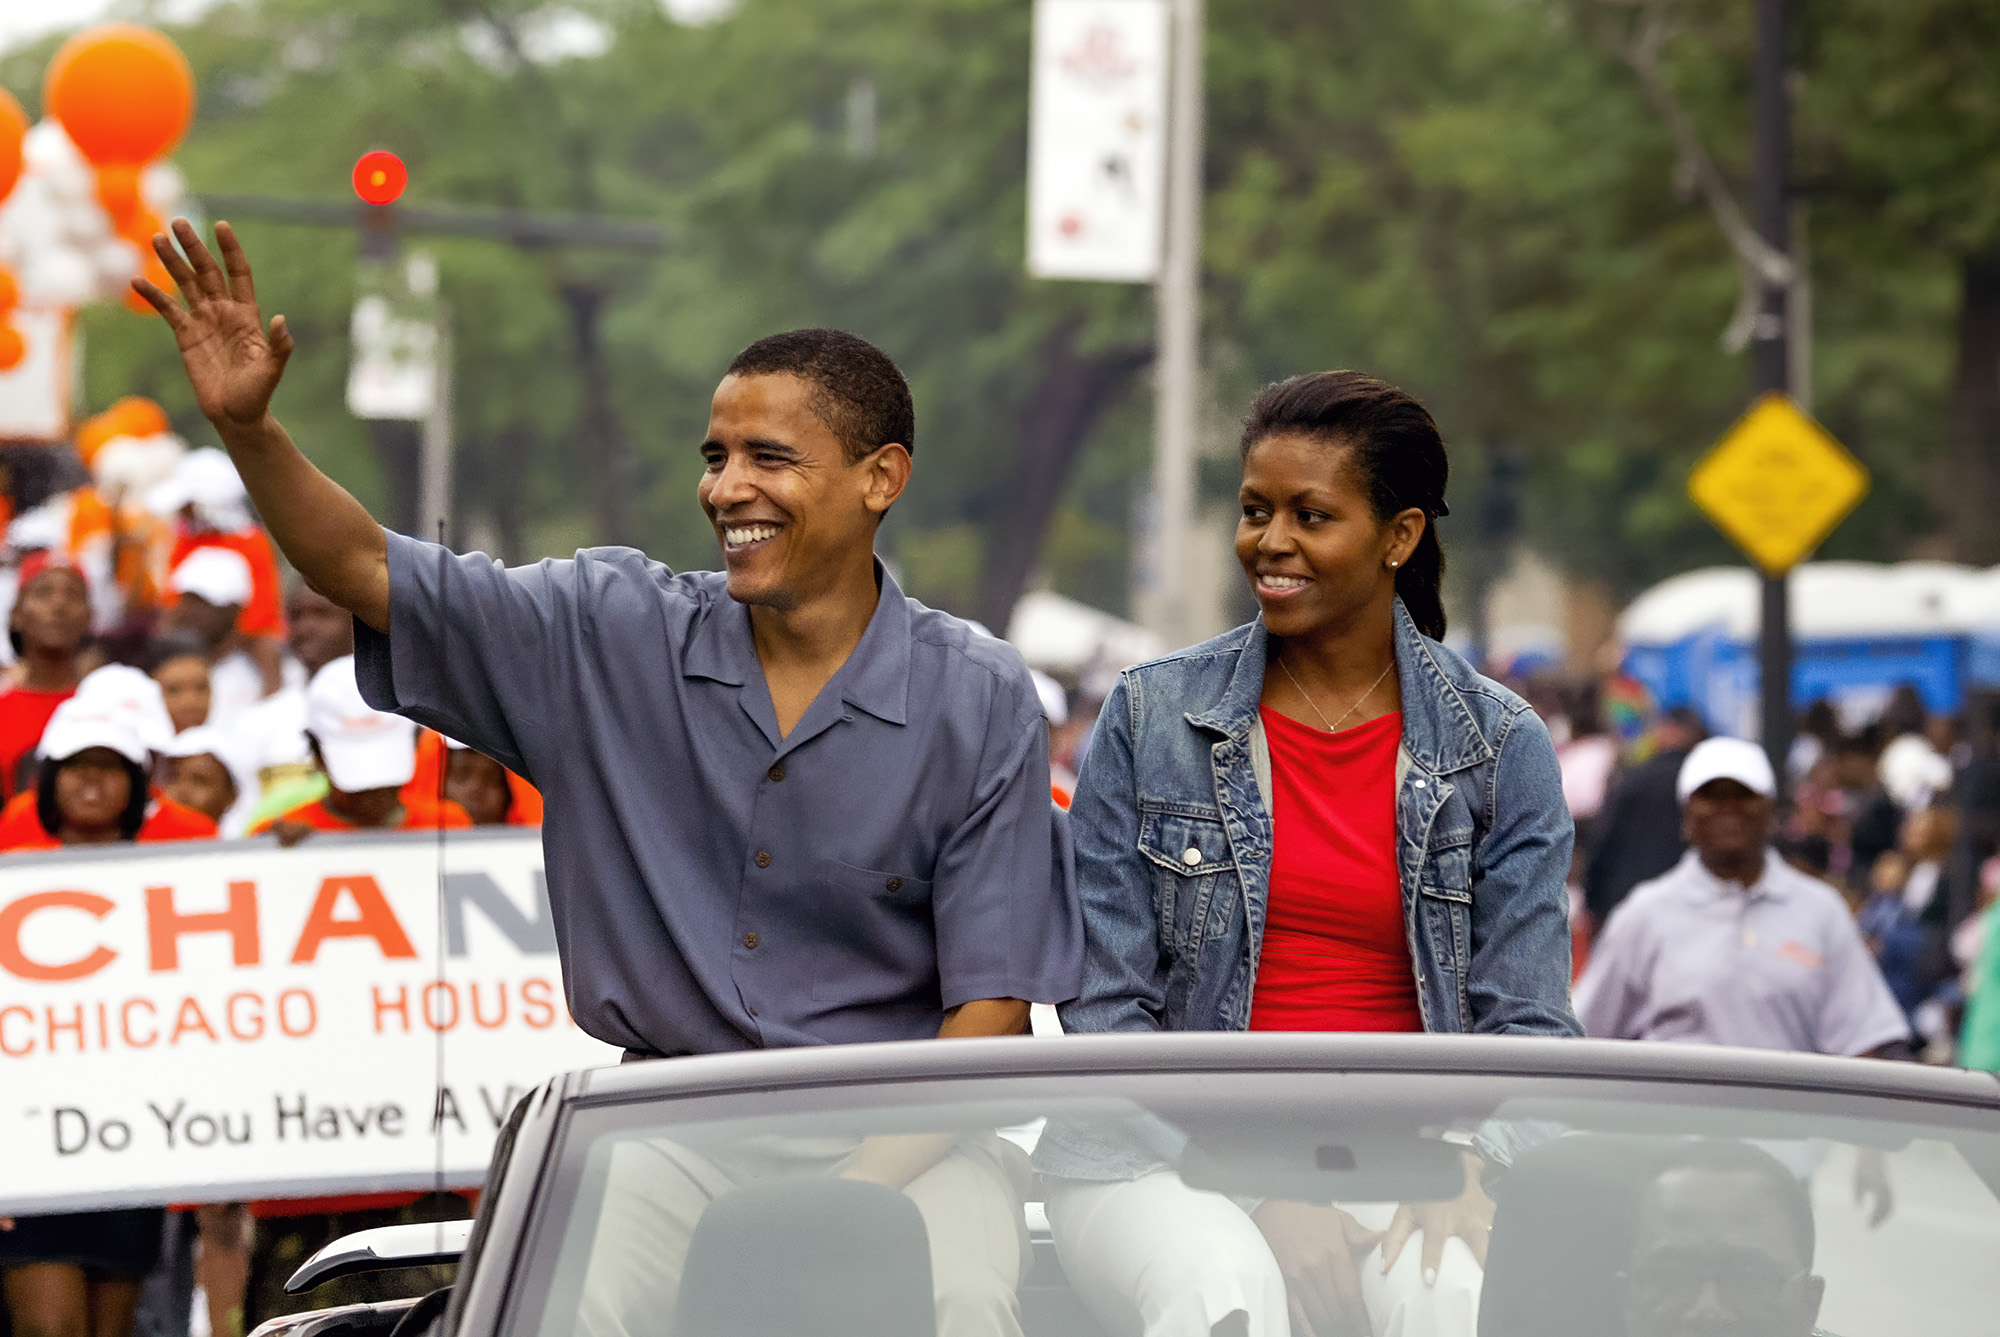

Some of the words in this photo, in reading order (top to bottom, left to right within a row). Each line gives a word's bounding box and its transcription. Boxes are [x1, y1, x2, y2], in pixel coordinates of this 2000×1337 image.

[0, 988, 318, 1058] CHICAGO
[372, 978, 577, 1035] HOUS
[148, 1098, 252, 1148] You
[274, 1093, 405, 1141] Have
[431, 1086, 467, 1134] A
